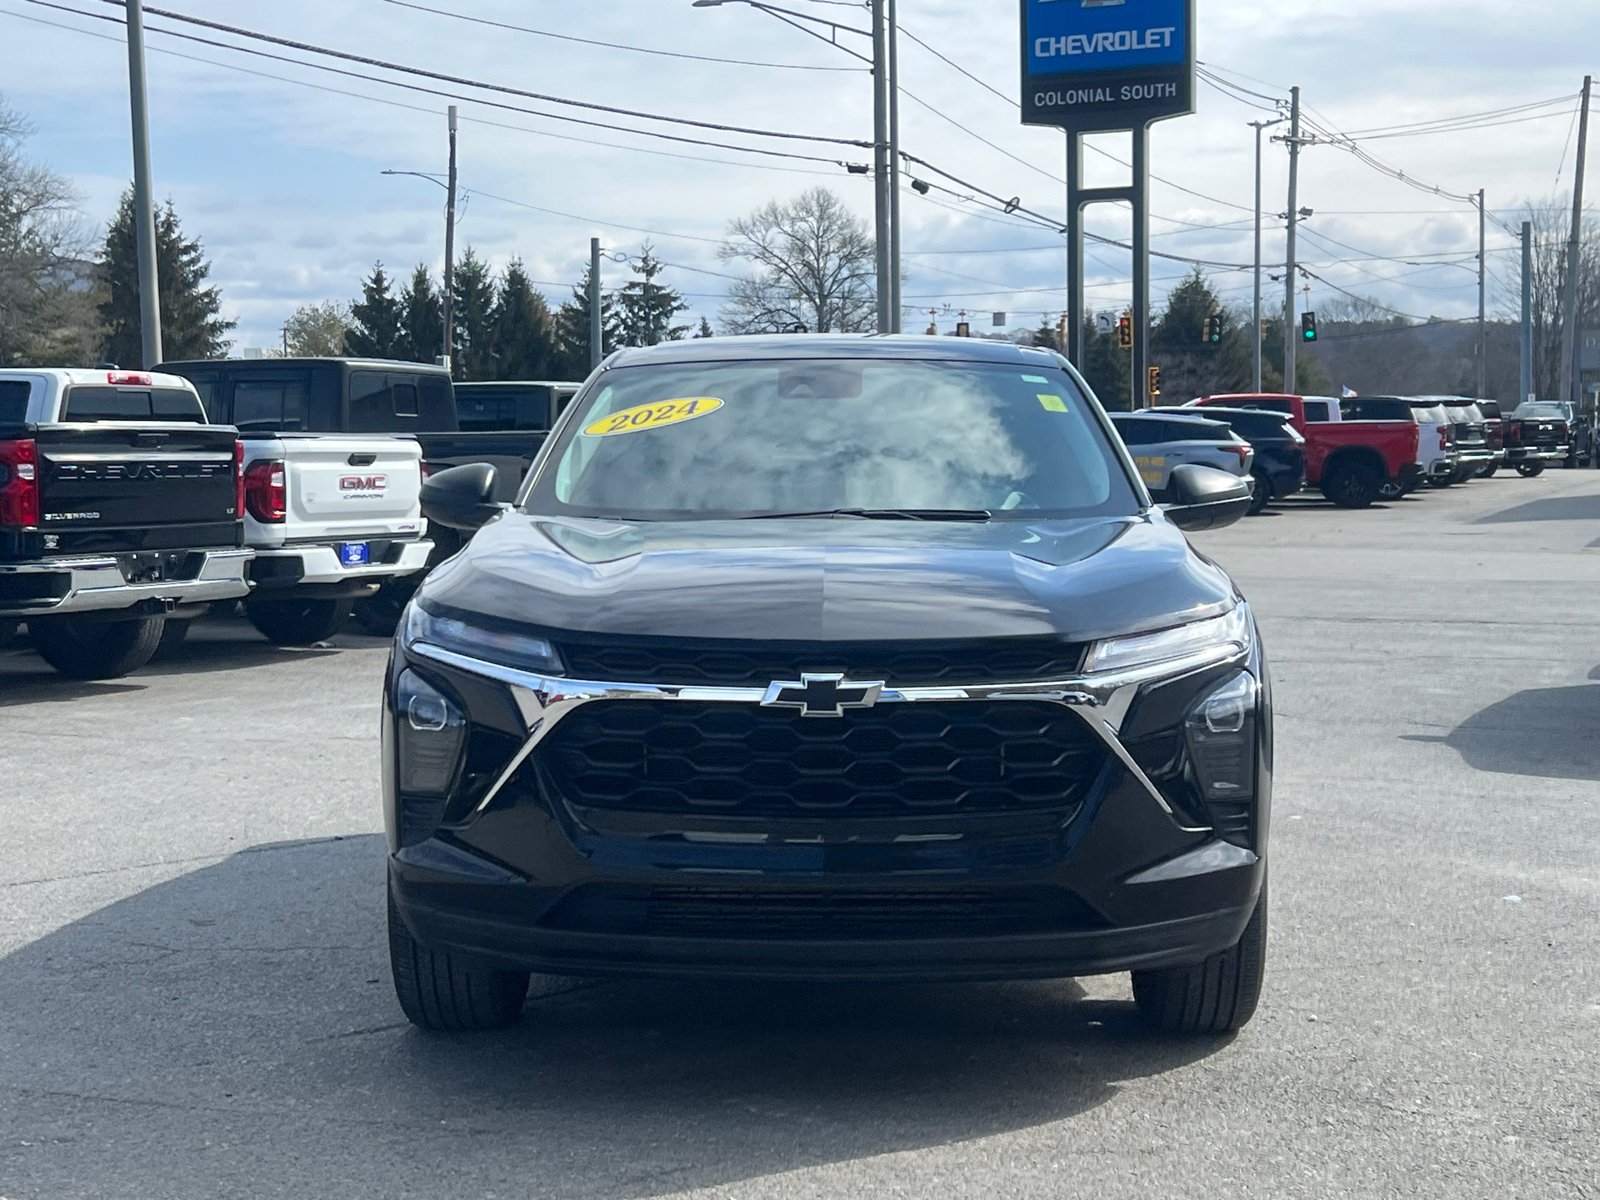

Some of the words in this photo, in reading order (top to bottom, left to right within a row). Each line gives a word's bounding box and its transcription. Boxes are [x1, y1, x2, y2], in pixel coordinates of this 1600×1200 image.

[1035, 27, 1175, 57] CHEVROLET
[1035, 87, 1115, 106] COLONIAL
[1121, 83, 1176, 100] SOUTH
[607, 400, 699, 433] 2024
[340, 476, 386, 490] GMC
